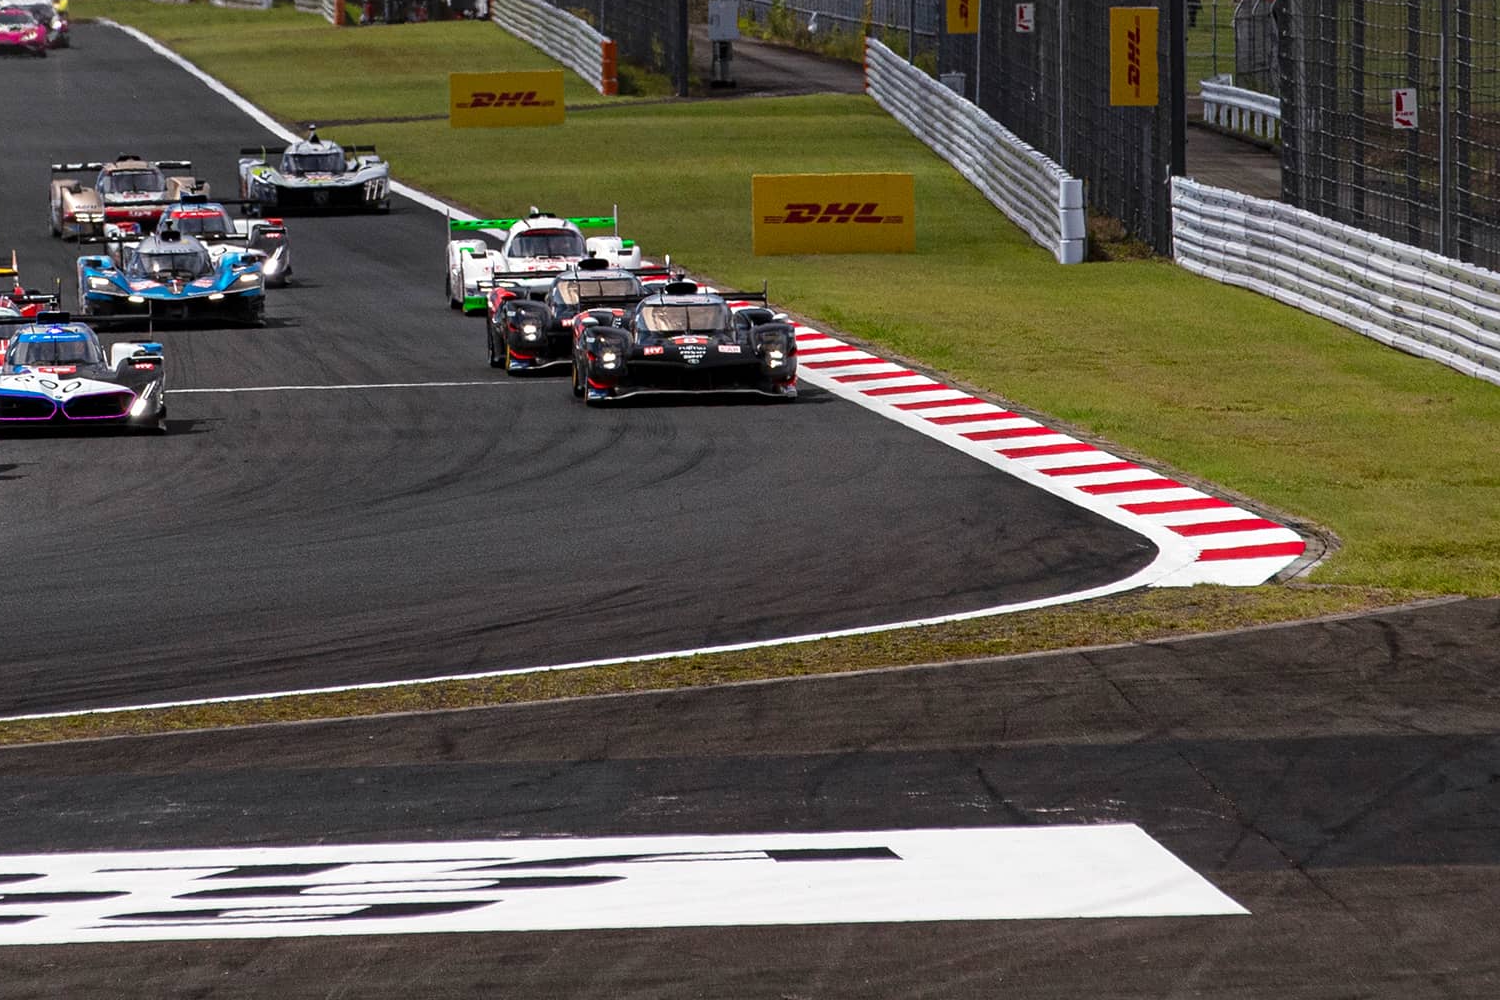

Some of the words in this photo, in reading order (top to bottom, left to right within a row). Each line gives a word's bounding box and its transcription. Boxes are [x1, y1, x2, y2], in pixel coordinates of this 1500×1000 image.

[1127, 26, 1140, 88] DHL
[468, 90, 543, 107] DHL
[782, 203, 887, 224] DHL
